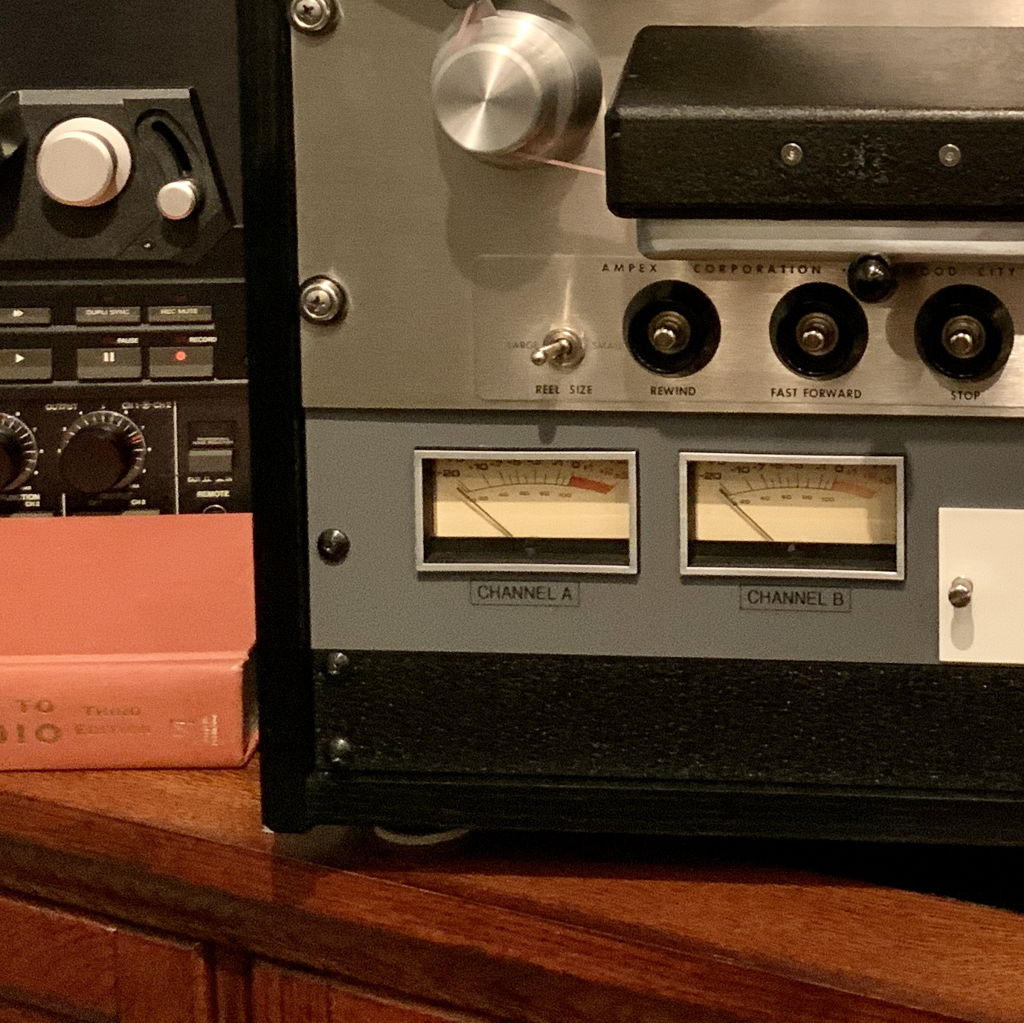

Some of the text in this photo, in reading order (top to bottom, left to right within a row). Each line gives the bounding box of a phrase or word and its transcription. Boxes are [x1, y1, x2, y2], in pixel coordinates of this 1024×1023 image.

[601, 263, 822, 274] AMPEX CORPORATION
[535, 385, 593, 395] REEL SIZE
[650, 386, 697, 397] REWIND
[771, 387, 862, 399] FAST FORWARD
[950, 390, 981, 401] STOP
[477, 585, 573, 601] CHANNEL A
[747, 591, 844, 607] CHANNEL B
